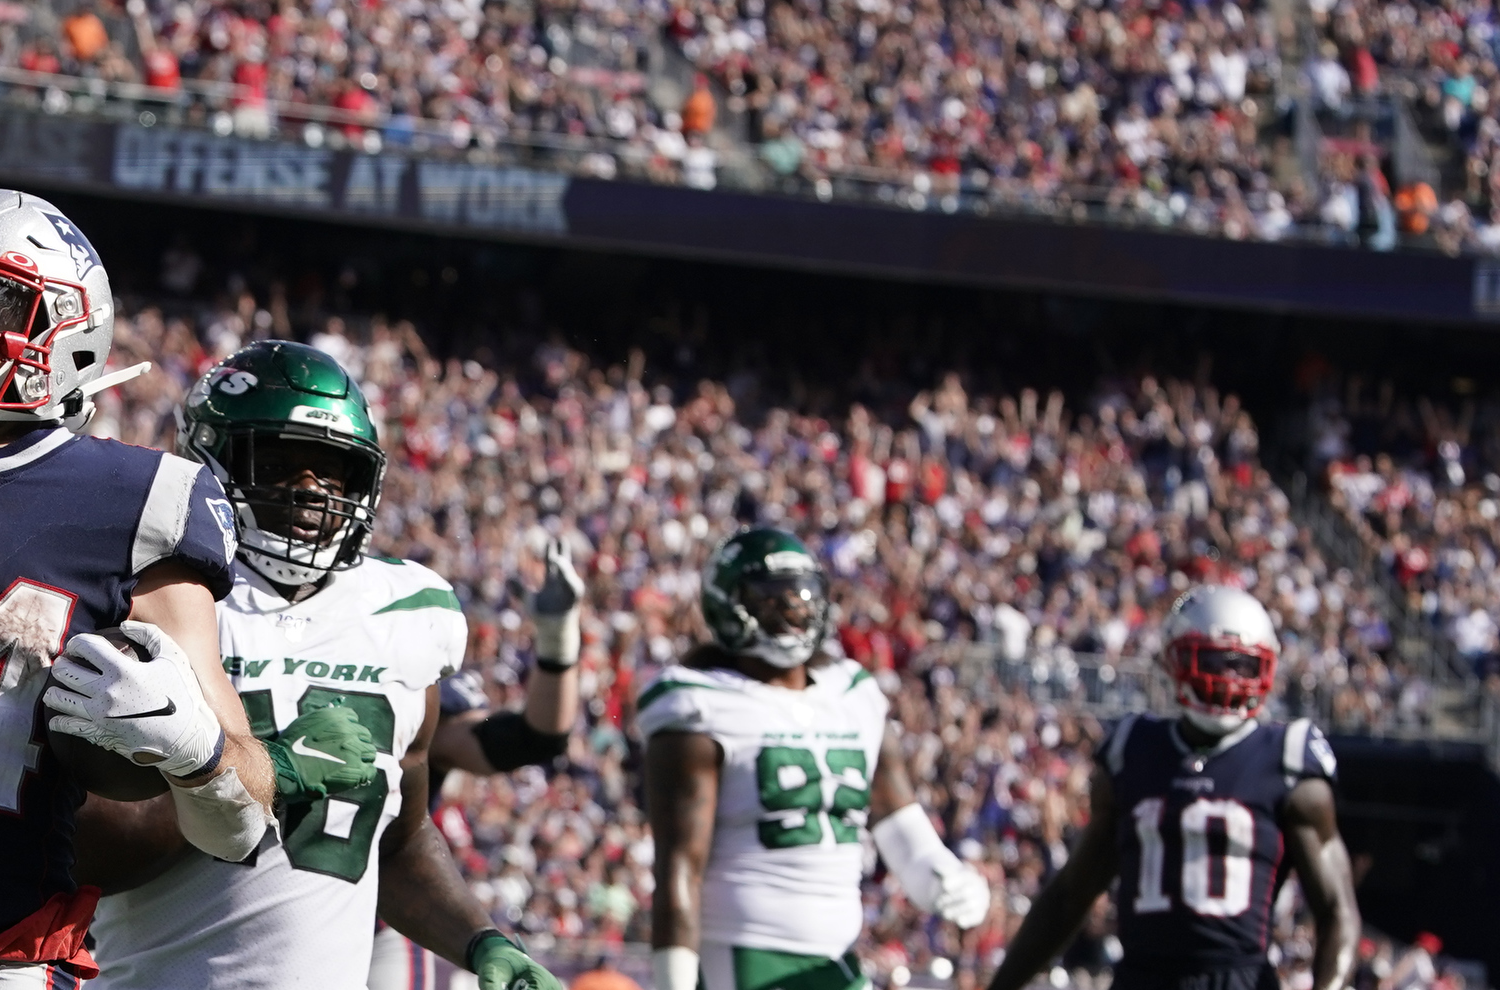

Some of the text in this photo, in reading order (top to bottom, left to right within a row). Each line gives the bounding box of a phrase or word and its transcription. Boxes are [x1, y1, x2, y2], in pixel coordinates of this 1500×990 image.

[111, 127, 332, 207] OFFENSE
[341, 154, 408, 214] AT
[416, 161, 569, 232] WORK
[222, 655, 389, 684] EW YORK
[756, 746, 871, 850] 92
[1131, 796, 1255, 918] 10
